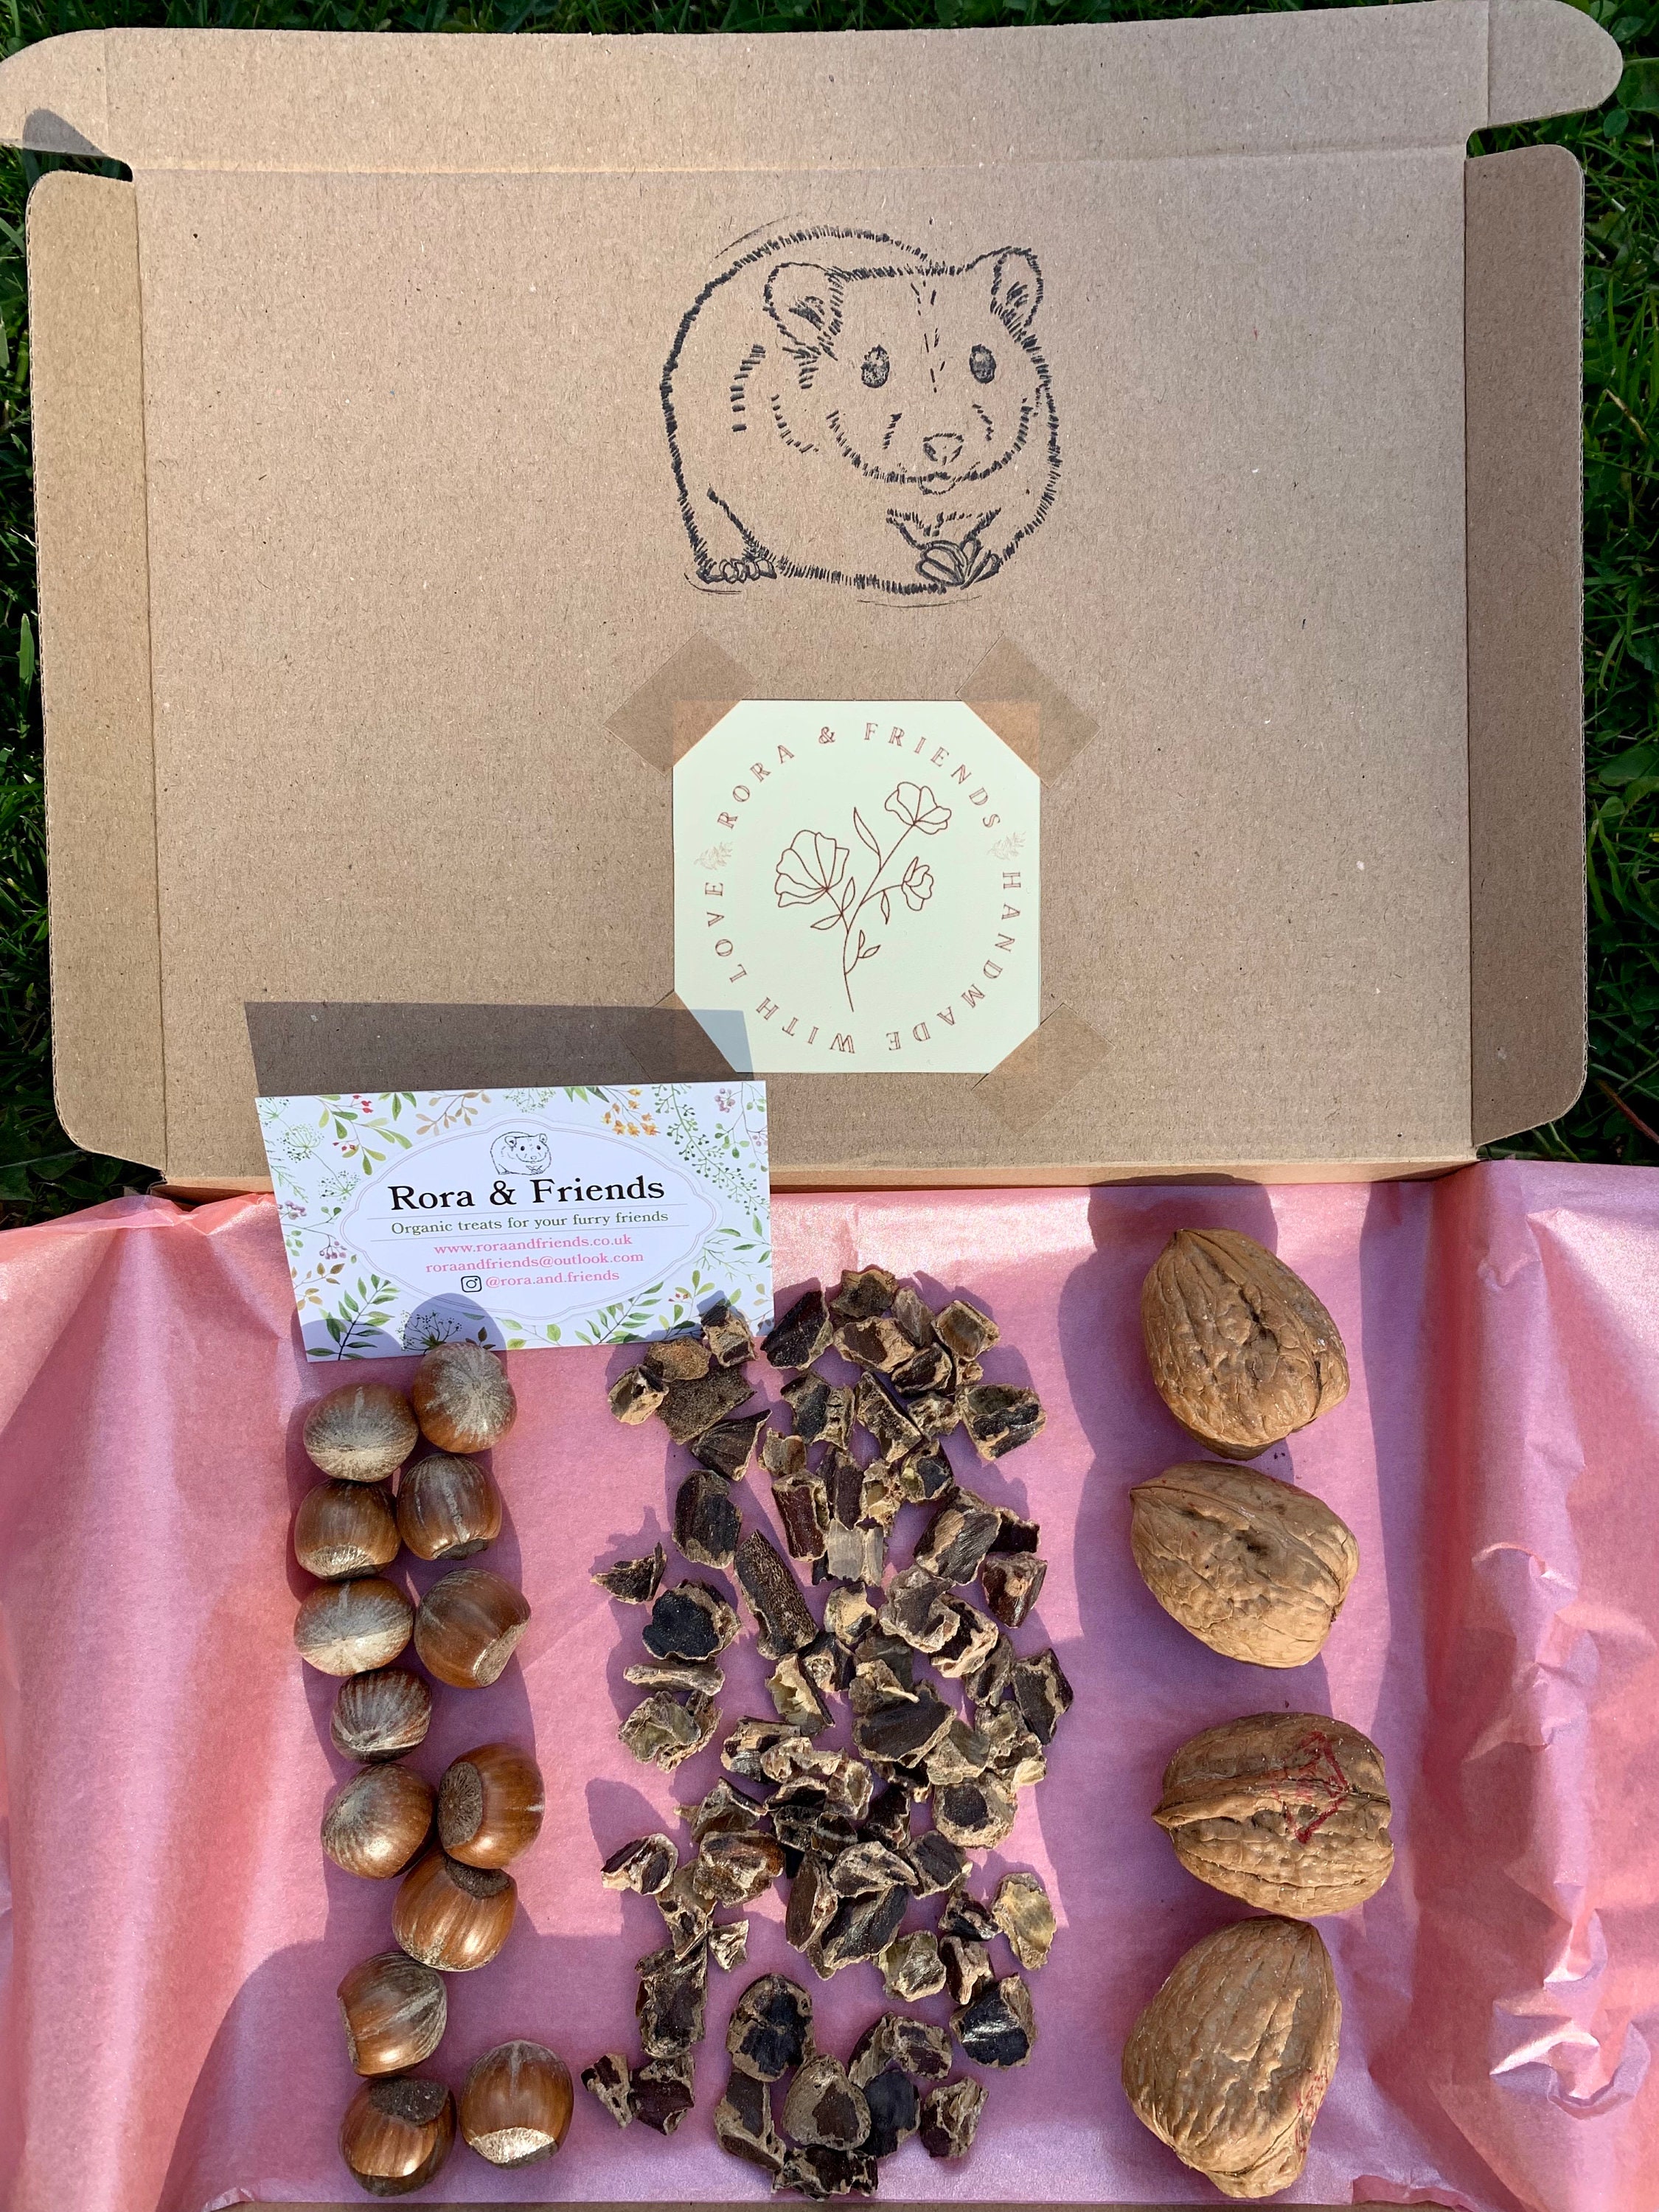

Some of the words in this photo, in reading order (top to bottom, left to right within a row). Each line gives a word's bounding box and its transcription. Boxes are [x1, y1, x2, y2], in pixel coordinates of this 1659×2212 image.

[717, 744, 795, 830] RORA
[818, 726, 837, 745] &
[863, 722, 1001, 829] FRIENDS
[704, 881, 748, 984] LOVE
[886, 871, 1022, 1051] HANDMADE
[755, 996, 856, 1054] WITH
[387, 1185, 476, 1211] Rora
[489, 1180, 518, 1206] &
[529, 1175, 665, 1203] Friends
[391, 1220, 453, 1236] Organic
[458, 1219, 503, 1231] treats
[507, 1217, 530, 1229] for
[534, 1217, 568, 1230] your
[572, 1214, 611, 1226] furry
[615, 1210, 669, 1223] friends
[434, 1234, 633, 1254] www.roraandfriends.co.uk
[425, 1252, 644, 1273] roraandfriends@outlook.com
[485, 1269, 620, 1288] @rora.and.friends
